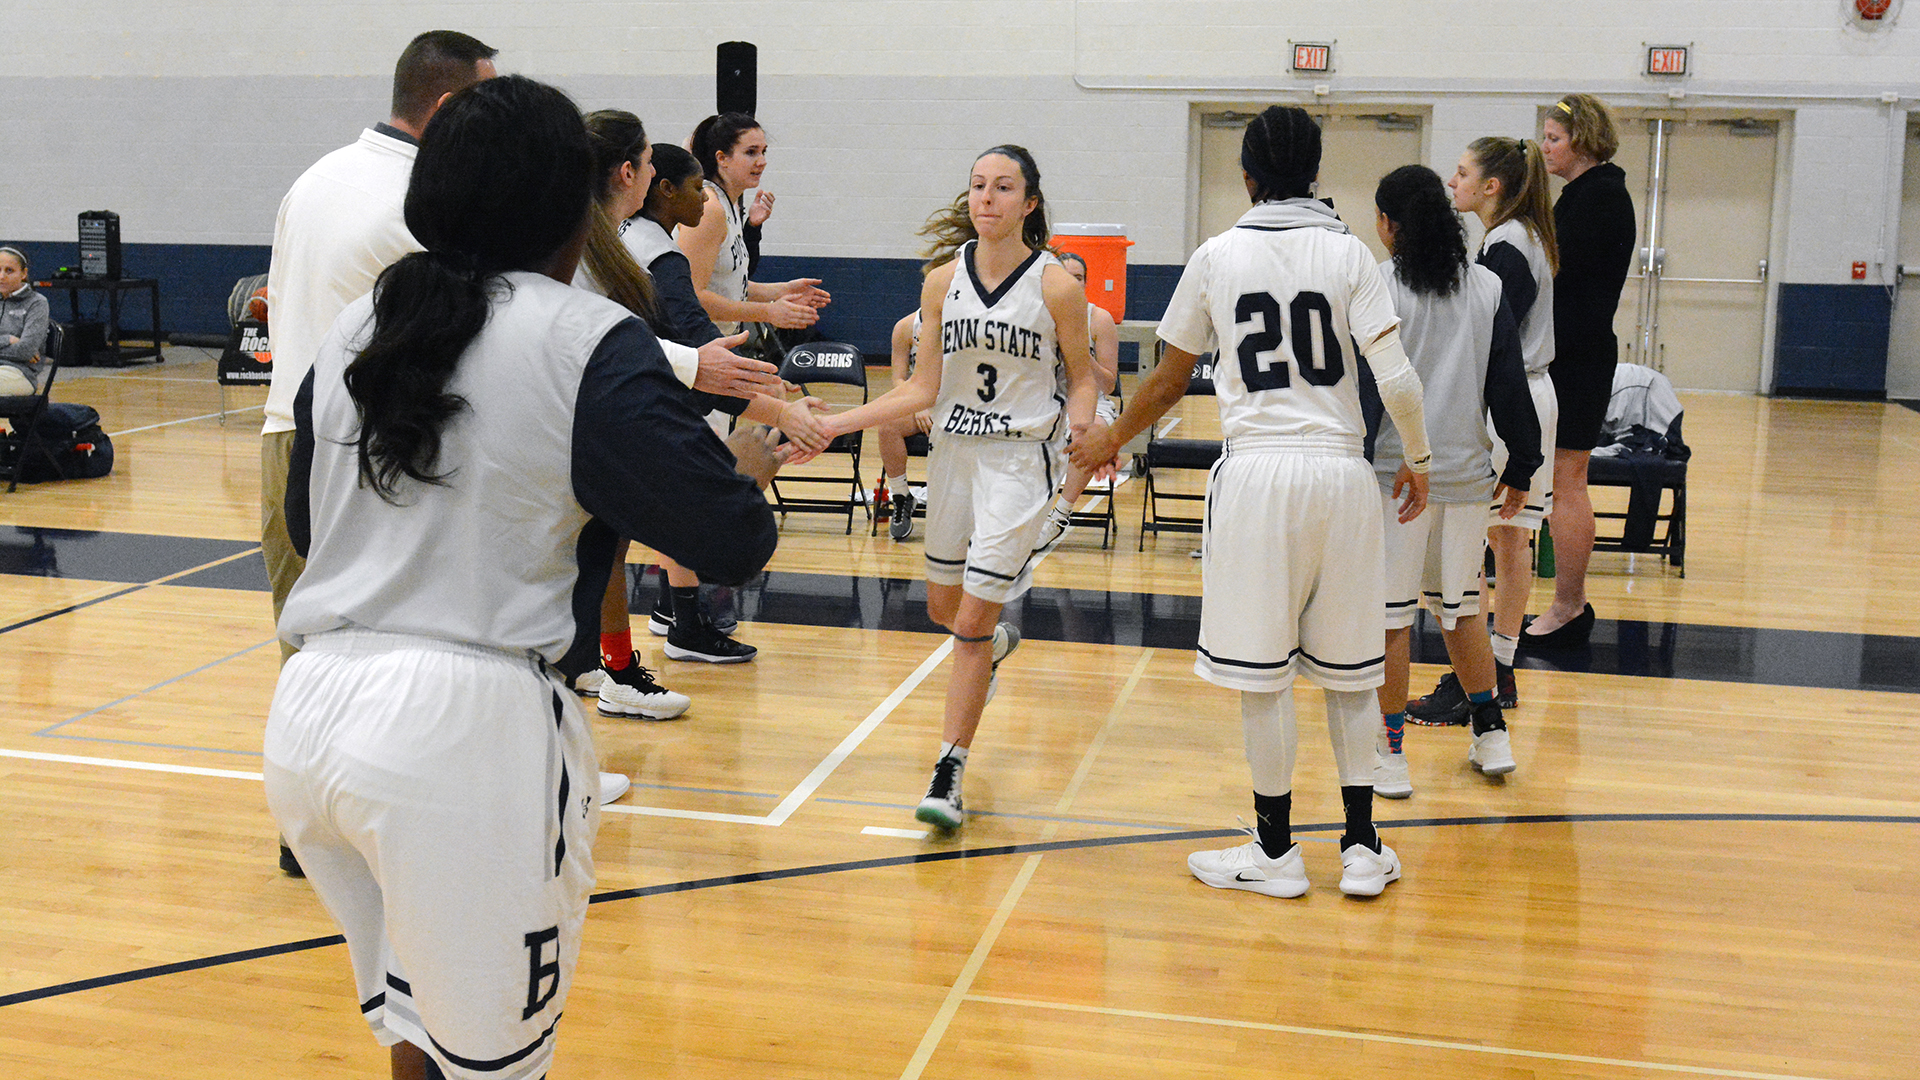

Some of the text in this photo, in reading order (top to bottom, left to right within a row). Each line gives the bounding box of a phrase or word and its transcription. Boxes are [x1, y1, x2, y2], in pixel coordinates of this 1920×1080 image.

[1296, 47, 1326, 69] EXIT
[1652, 50, 1684, 72] EXIT
[243, 327, 259, 337] THE
[941, 318, 1042, 361] ENN STATE
[1234, 290, 1346, 393] 20
[816, 353, 854, 368] BERKS
[976, 362, 998, 403] 3
[522, 925, 560, 1021] B
